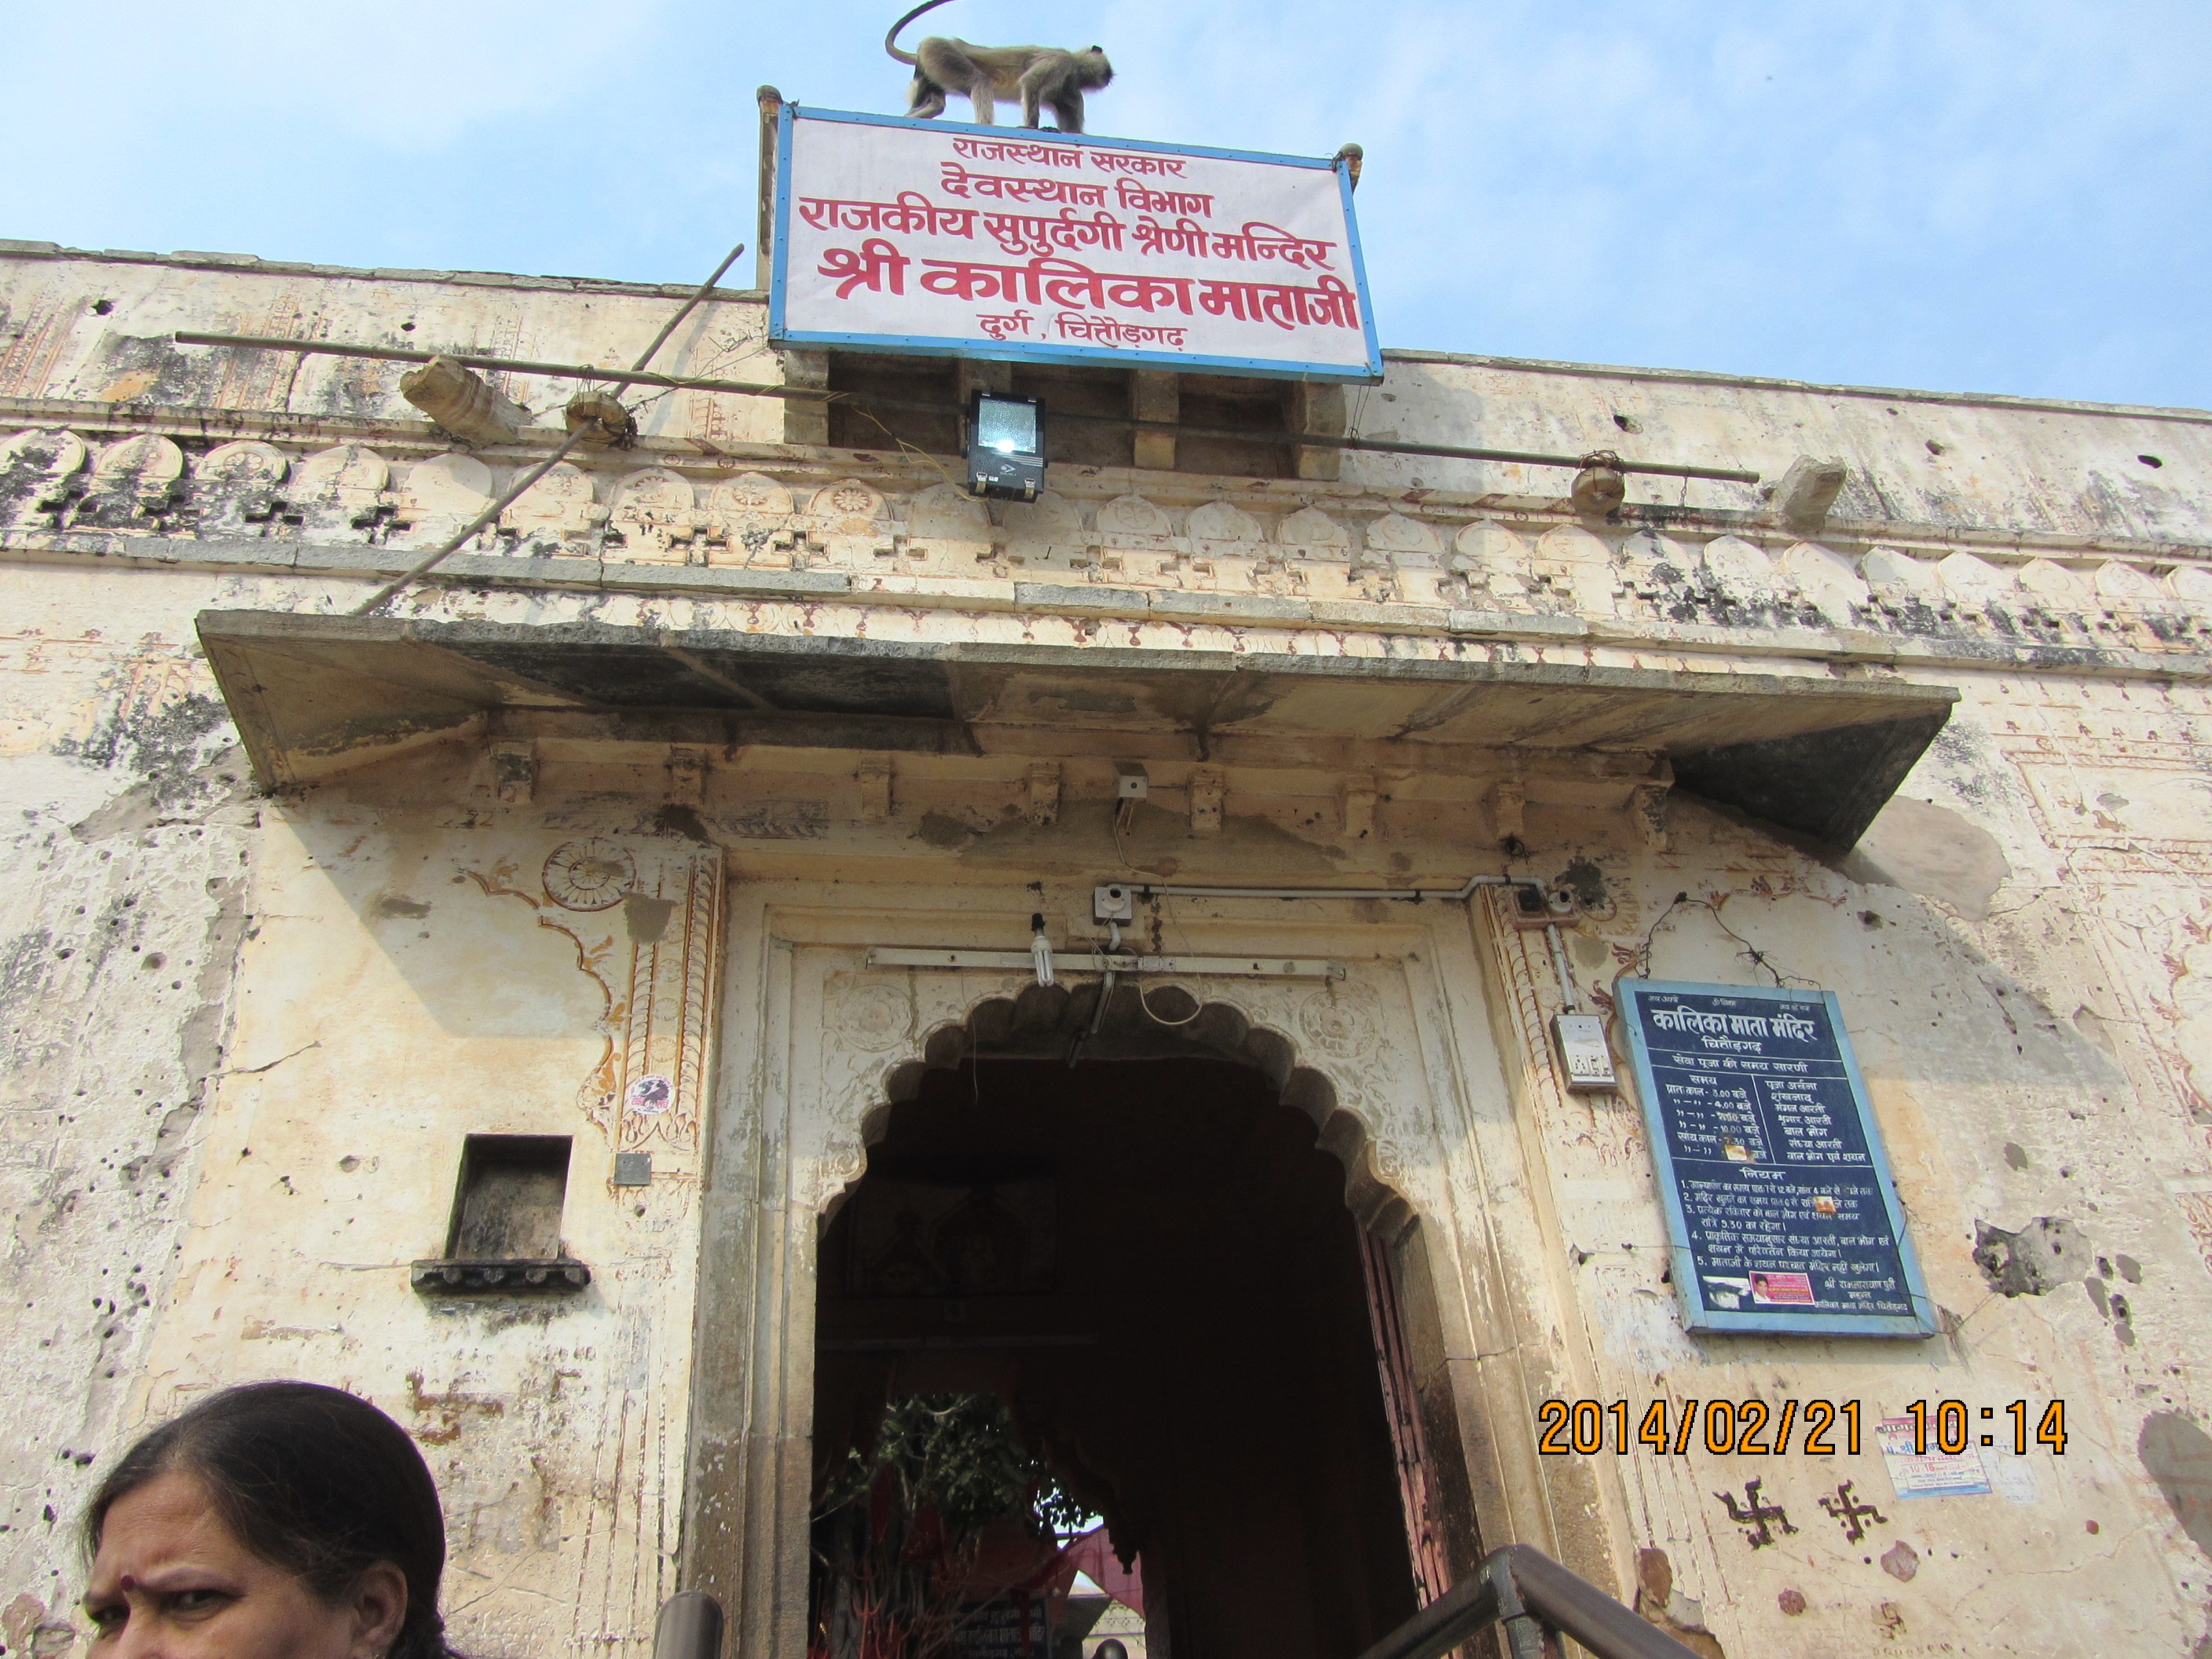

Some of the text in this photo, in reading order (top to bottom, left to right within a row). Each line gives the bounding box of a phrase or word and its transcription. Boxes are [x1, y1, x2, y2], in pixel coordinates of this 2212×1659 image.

[953, 137, 1188, 178] राजस्थान सरकार
[940, 162, 1215, 218] देवस्थान विभाग
[799, 191, 1337, 271] राजकीय सुपुर्दगी श्रेणी मन्दिर
[818, 238, 1360, 331] श्री कालिका माताजी
[1651, 1005, 1818, 1042] कालिका माता मंदिर
[1672, 1053, 1808, 1073] सेवा पूजा की समय सारणी
[1689, 1075, 1718, 1086] समय
[1764, 1079, 1818, 1090] पूजा अर्चना
[1731, 1087, 1748, 1100] बजे
[1736, 1100, 1752, 1111] बजे
[1774, 1102, 1826, 1114] मंगल आरती
[1739, 1111, 1757, 1123] बजे
[1743, 1123, 1761, 1135] बजे
[1783, 1125, 1828, 1137] बाल भोग
[1748, 1135, 1764, 1147] बजे
[1815, 1137, 1843, 1149] आरती
[1786, 1152, 1805, 1161] बाल
[1806, 1149, 1824, 1161] भोग
[1842, 1152, 1866, 1162] शयन
[1738, 1166, 1786, 1180] नियम
[1683, 1192, 1694, 1201] 2.
[1694, 1191, 1713, 1203] मंदिर
[1737, 1196, 1747, 1204] का
[1844, 1199, 1859, 1208] तक
[1685, 1204, 1695, 1214] 3.
[1764, 1210, 1779, 1218] बाल
[1781, 1207, 1797, 1219] भोग
[1798, 1210, 1810, 1220] एवं
[1721, 1219, 1742, 1229] 9.30
[1691, 1230, 1702, 1240] 4.
[1840, 1236, 1856, 1245] बाल
[1857, 1234, 1876, 1246] भोग
[1708, 1243, 1732, 1254] शयन
[1787, 1246, 1810, 1257] किया
[1697, 1256, 1708, 1265] 5.
[1711, 1255, 1742, 1268] माताजी
[1744, 1256, 1752, 1268] के
[1754, 1258, 1776, 1269] शयन
[1808, 1259, 1830, 1272] मंदिर
[1824, 1276, 1836, 1290] श्री
[1883, 1277, 1897, 1291] पुरी
